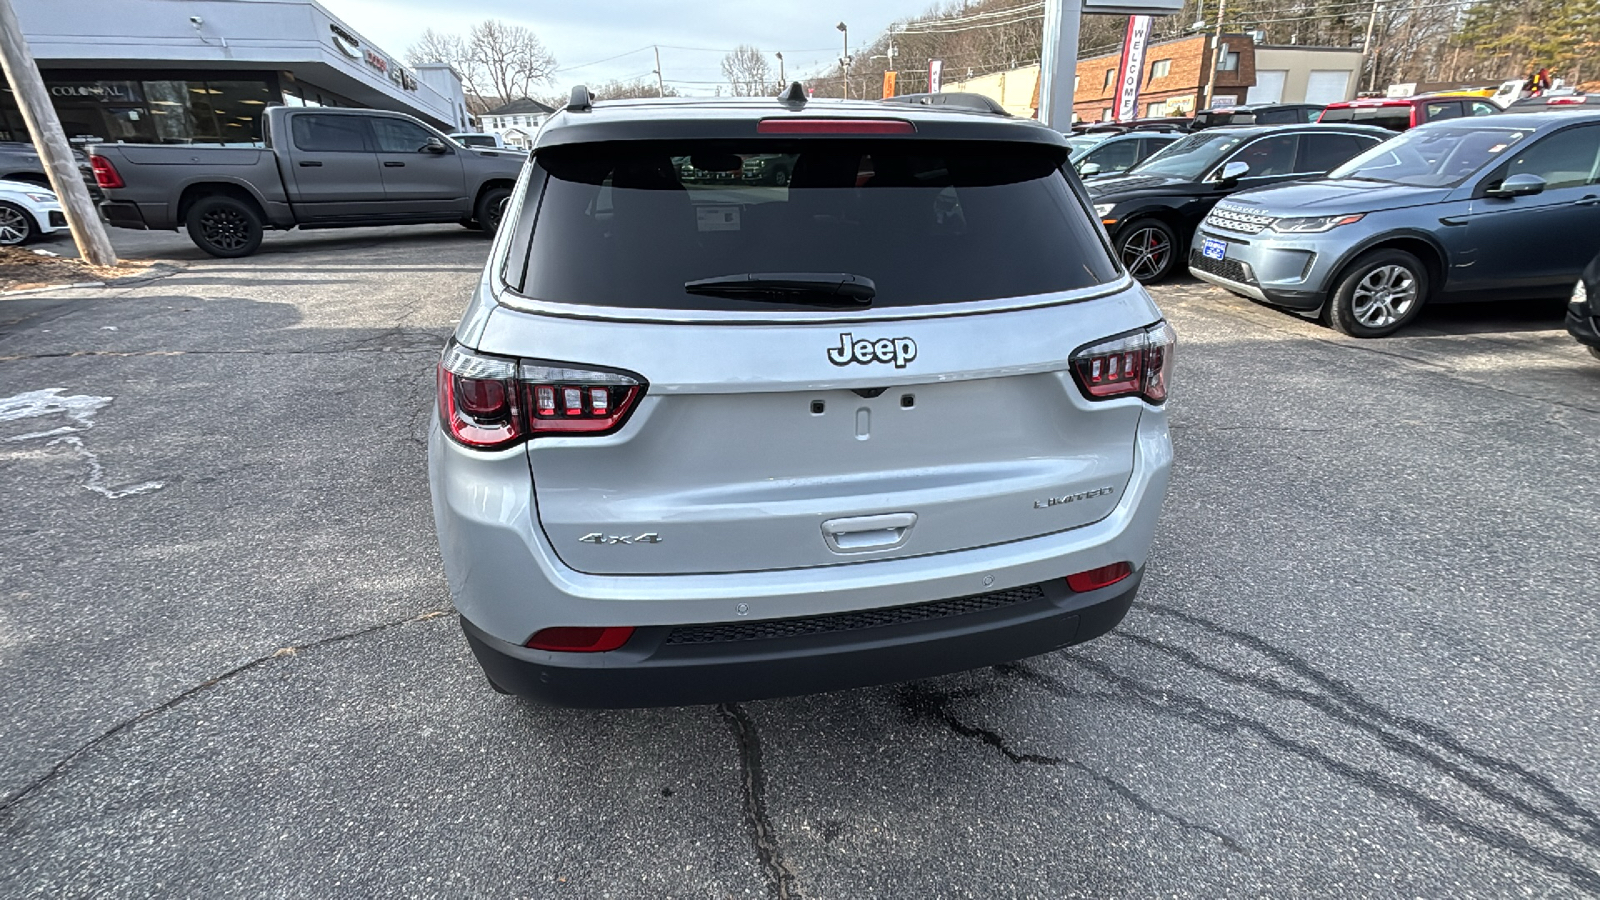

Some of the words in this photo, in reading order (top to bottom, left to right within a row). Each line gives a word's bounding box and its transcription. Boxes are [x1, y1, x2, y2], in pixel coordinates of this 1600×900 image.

[1124, 29, 1144, 108] WELCOME
[1220, 203, 1269, 214] DISCOVERY
[827, 332, 917, 369] Jeep
[1033, 486, 1114, 509] LIMITED
